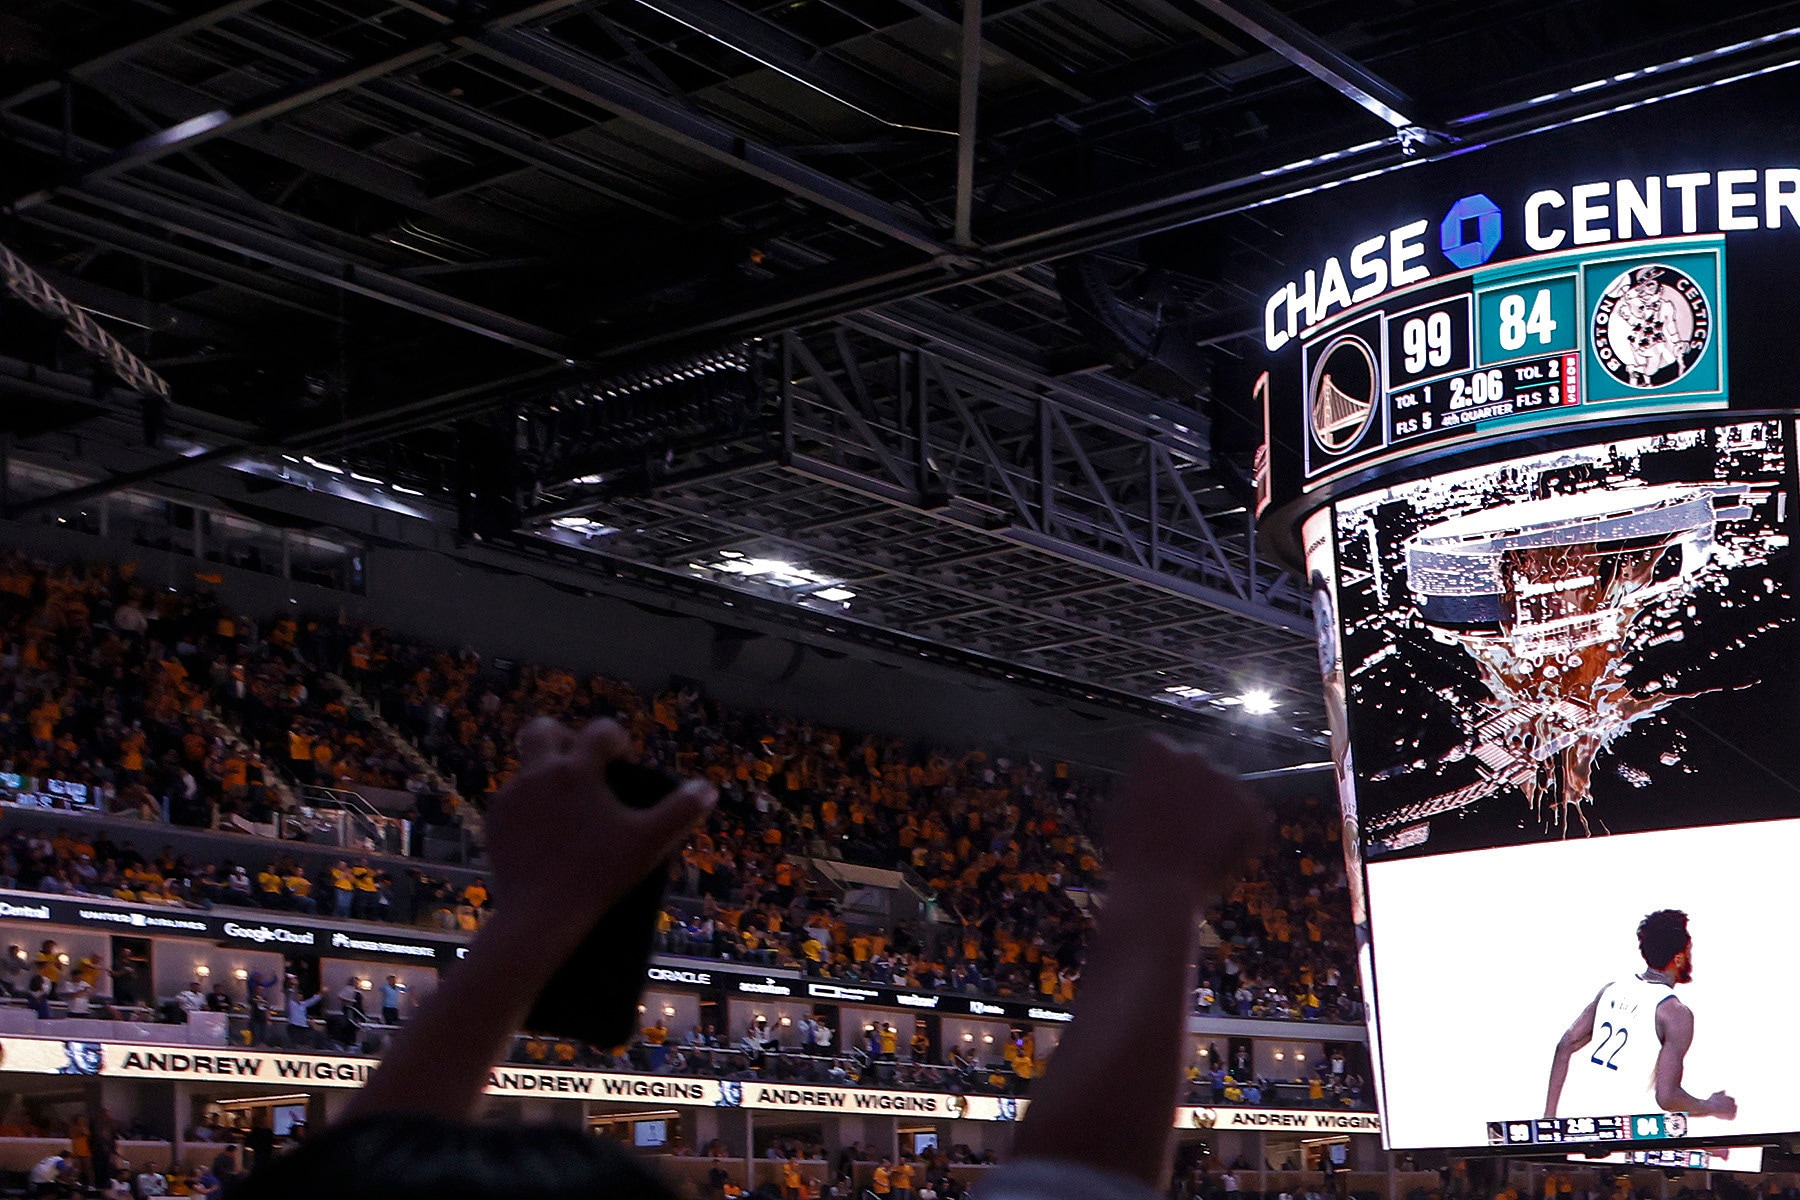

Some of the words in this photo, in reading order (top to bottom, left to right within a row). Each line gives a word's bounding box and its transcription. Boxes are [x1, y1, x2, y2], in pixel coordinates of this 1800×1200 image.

[1264, 218, 1431, 352] CHASE
[1498, 287, 1558, 351] 84
[1676, 278, 1708, 350] CELTICS
[1402, 311, 1452, 374] 99
[1595, 295, 1622, 372] BOSTON
[1515, 366, 1543, 381] TOL
[1548, 360, 1560, 378] 2
[1395, 393, 1419, 409] TOL
[1423, 385, 1432, 403] 1
[1450, 369, 1503, 410] 2:06
[1516, 392, 1542, 408] FLS
[1548, 386, 1560, 404] 3
[1396, 420, 1418, 435] FLS
[1421, 411, 1432, 430] 5
[1461, 403, 1514, 422] QUARTER
[223, 922, 274, 943] Google
[274, 929, 315, 946] Cloud
[648, 968, 712, 985] ORACLE
[1590, 1021, 1629, 1071] 22
[122, 1051, 264, 1076] ANDREW
[275, 1059, 374, 1083] WIGGI
[486, 1071, 594, 1095] ANDREW
[601, 1079, 703, 1099] WIGGINS
[757, 1088, 847, 1107] ANDREW
[855, 1094, 936, 1112] WIGGINS
[1232, 1113, 1309, 1127] ANDREW
